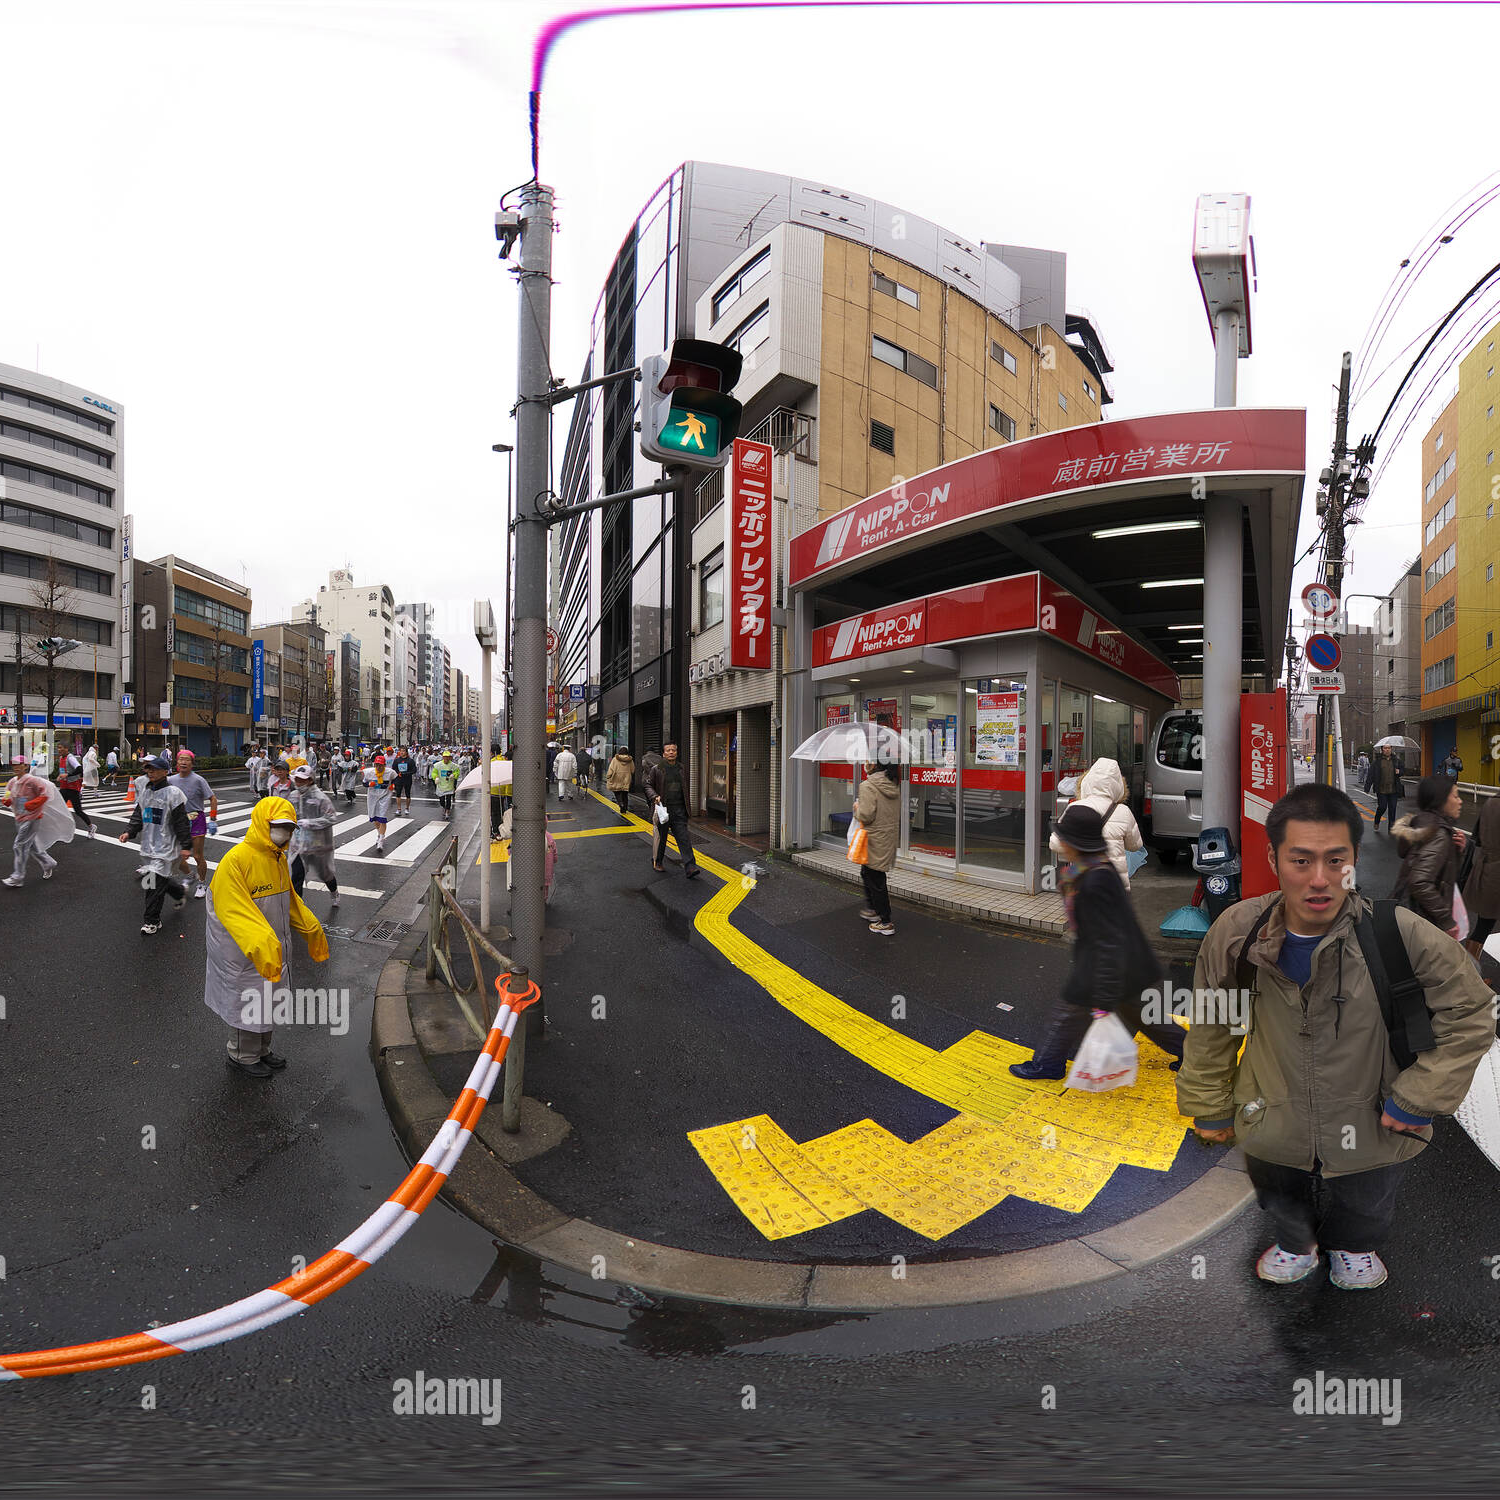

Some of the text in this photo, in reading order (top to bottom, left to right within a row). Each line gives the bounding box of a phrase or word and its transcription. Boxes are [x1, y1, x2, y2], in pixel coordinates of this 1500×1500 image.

[83, 396, 117, 415] CARL
[1052, 441, 1233, 485] 蔵前営業所
[857, 482, 950, 537] NIPPON
[861, 510, 937, 547] Rent-A-Car
[1310, 592, 1330, 609] 30
[858, 612, 922, 643] NIPPON
[862, 633, 915, 652] Rent-A-Car
[1251, 723, 1265, 790] NIPPON
